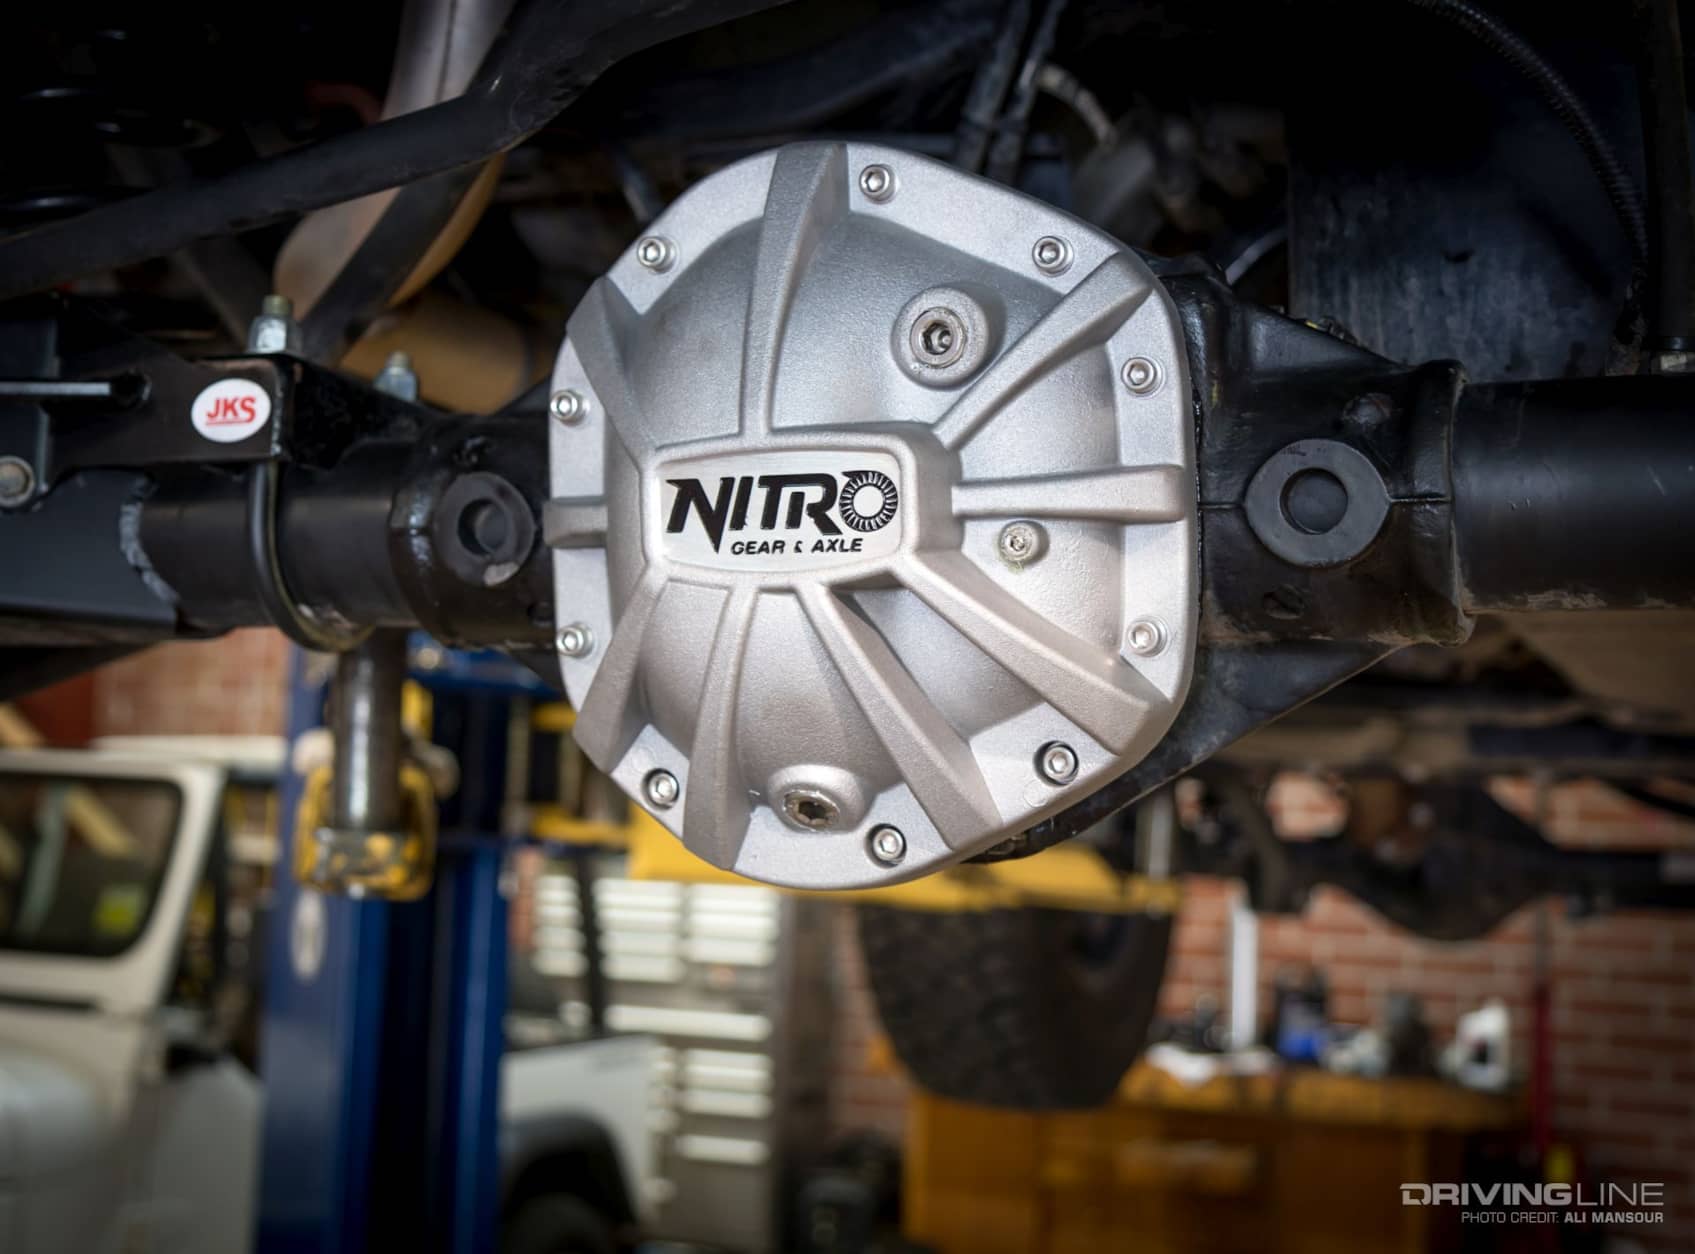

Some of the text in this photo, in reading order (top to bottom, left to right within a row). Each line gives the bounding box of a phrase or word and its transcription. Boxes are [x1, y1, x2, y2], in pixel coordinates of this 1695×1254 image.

[206, 396, 257, 424] JKS
[665, 470, 898, 554] NITRO
[731, 540, 786, 555] GEAR
[811, 538, 863, 553] AXLE
